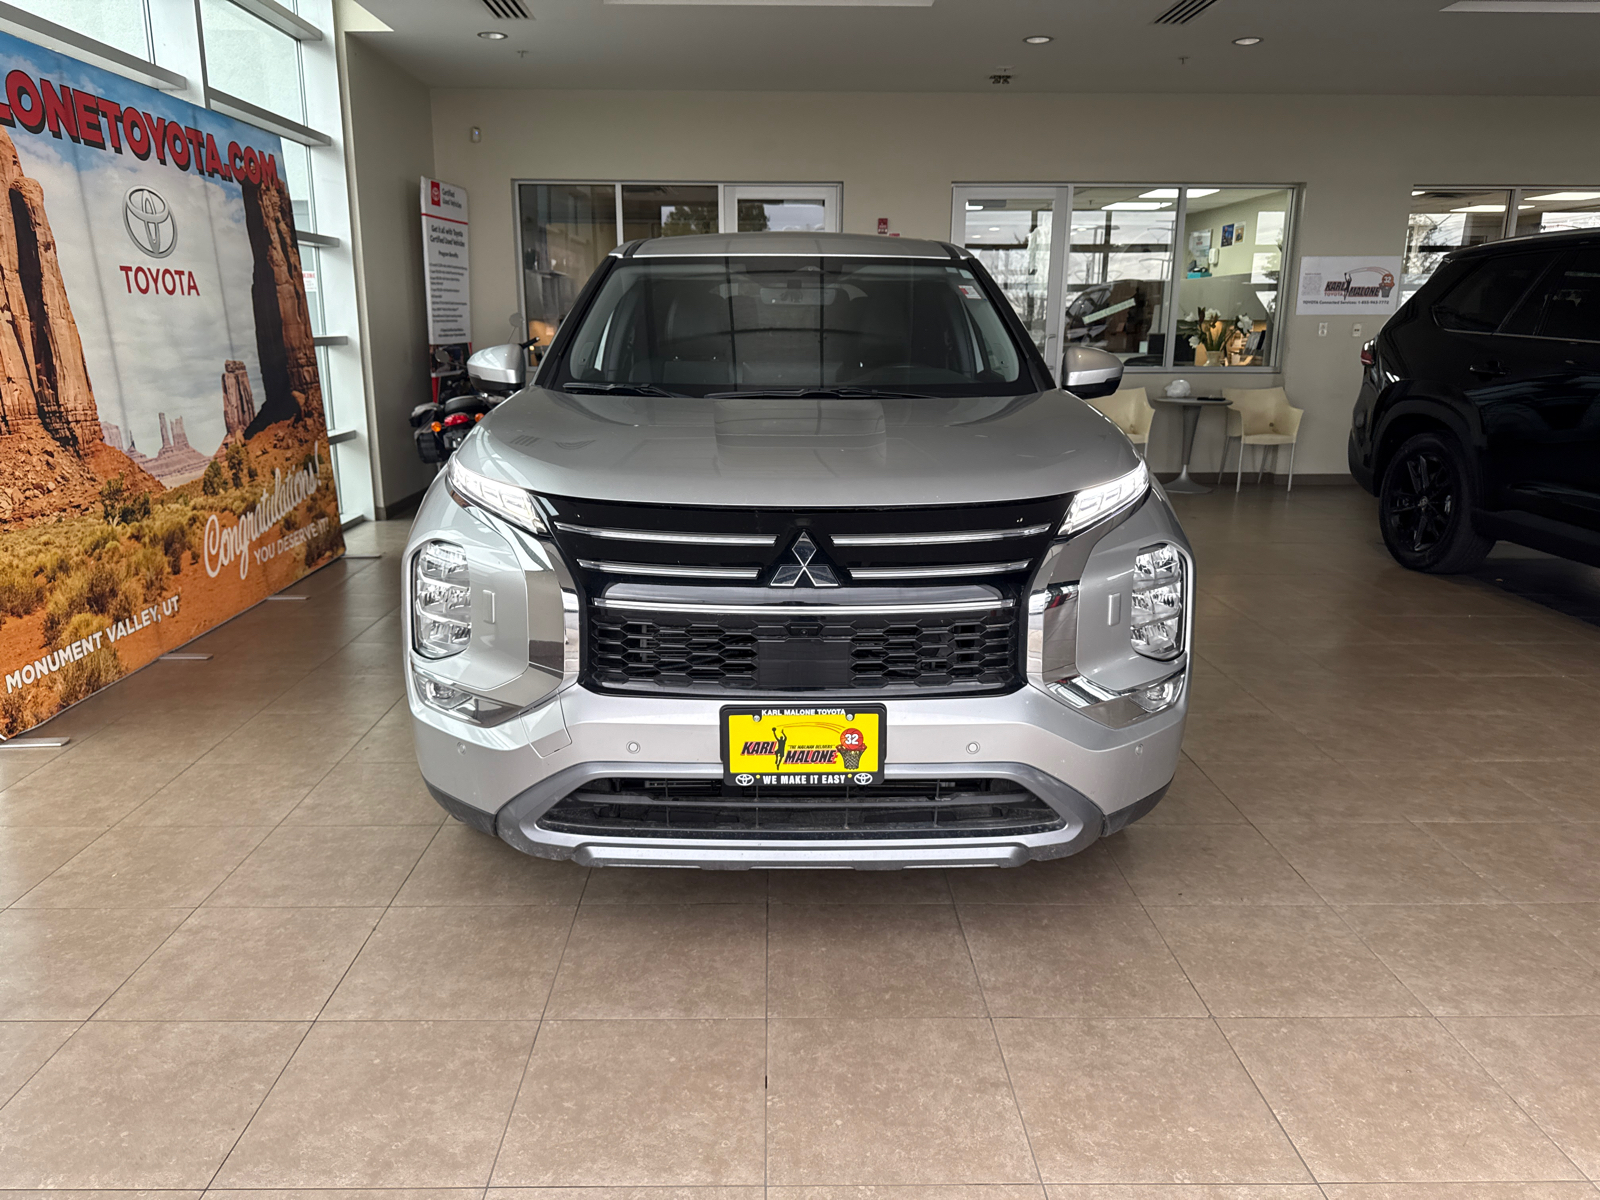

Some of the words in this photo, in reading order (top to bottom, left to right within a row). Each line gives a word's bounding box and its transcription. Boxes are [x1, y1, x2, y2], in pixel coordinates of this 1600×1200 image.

[119, 265, 201, 297] TOYOTA
[1383, 276, 1392, 284] 32
[1324, 281, 1346, 291] KARL
[1348, 286, 1380, 297] MALONE
[203, 440, 322, 580] Congratulations!
[254, 541, 275, 566] YOU
[277, 522, 318, 555] DESERVE
[316, 516, 330, 537] IT!
[5, 631, 103, 694] MONUMENT
[105, 604, 162, 644] VALLEY,
[162, 595, 180, 617] UT
[844, 733, 859, 745] 32
[740, 741, 778, 756] KARL
[783, 749, 838, 765] MALONE
[763, 775, 777, 784] WE
[780, 775, 807, 784] MAKE
[810, 775, 818, 784] IT
[821, 774, 846, 784] EASY
